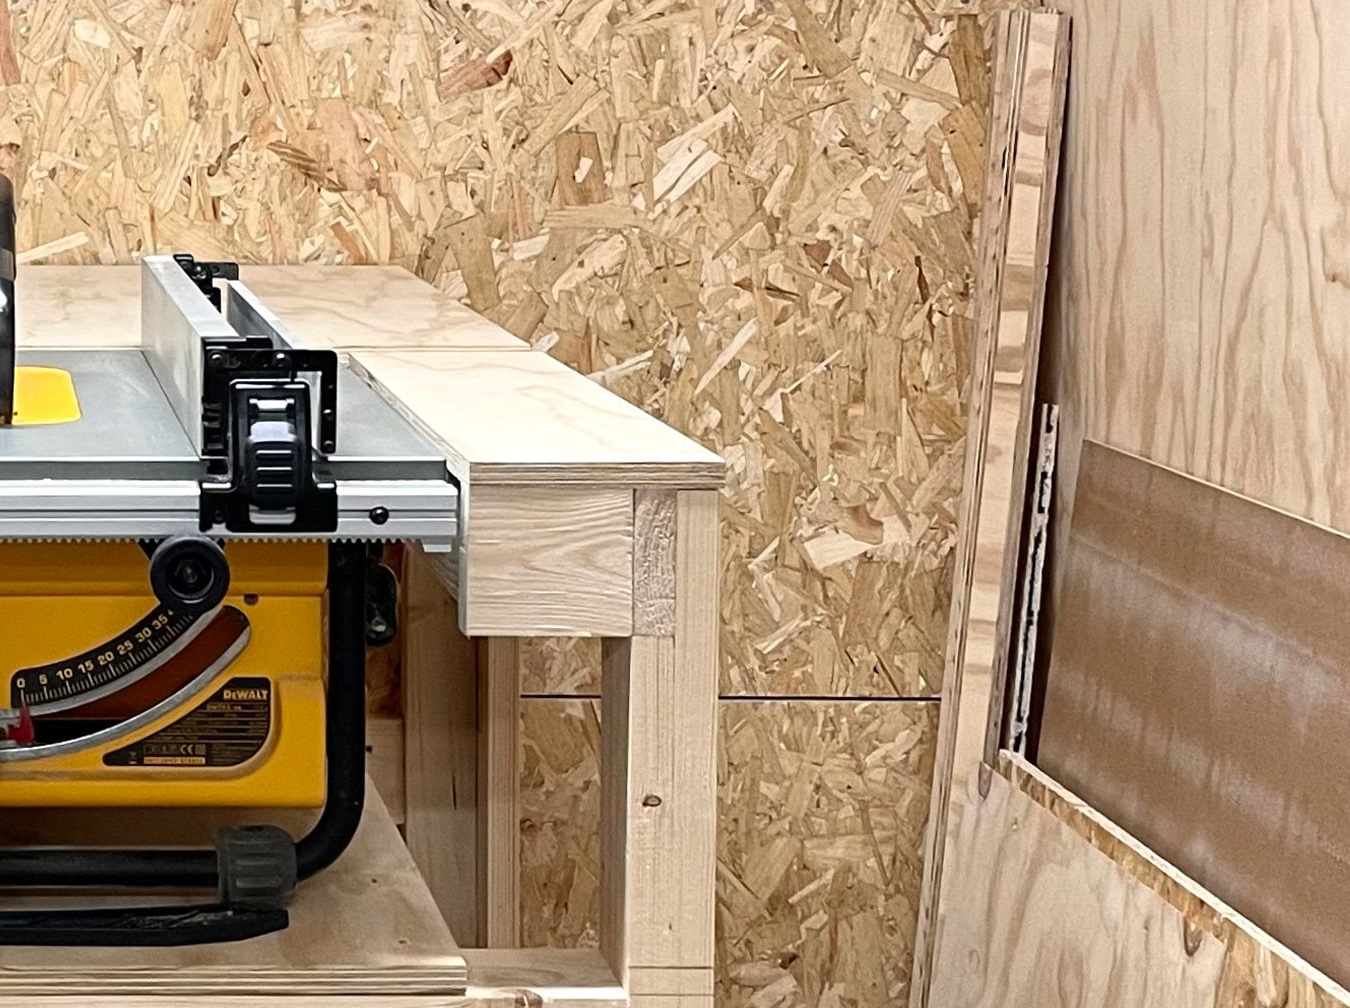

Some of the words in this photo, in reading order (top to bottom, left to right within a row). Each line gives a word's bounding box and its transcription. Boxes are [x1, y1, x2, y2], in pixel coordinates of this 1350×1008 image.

[16, 677, 26, 689] 0
[38, 673, 48, 685] 5
[56, 667, 74, 681] 10
[77, 659, 95, 674] 15
[97, 650, 115, 666] 20
[116, 639, 134, 656] 25
[134, 626, 152, 643] 30
[151, 614, 169, 630] 35
